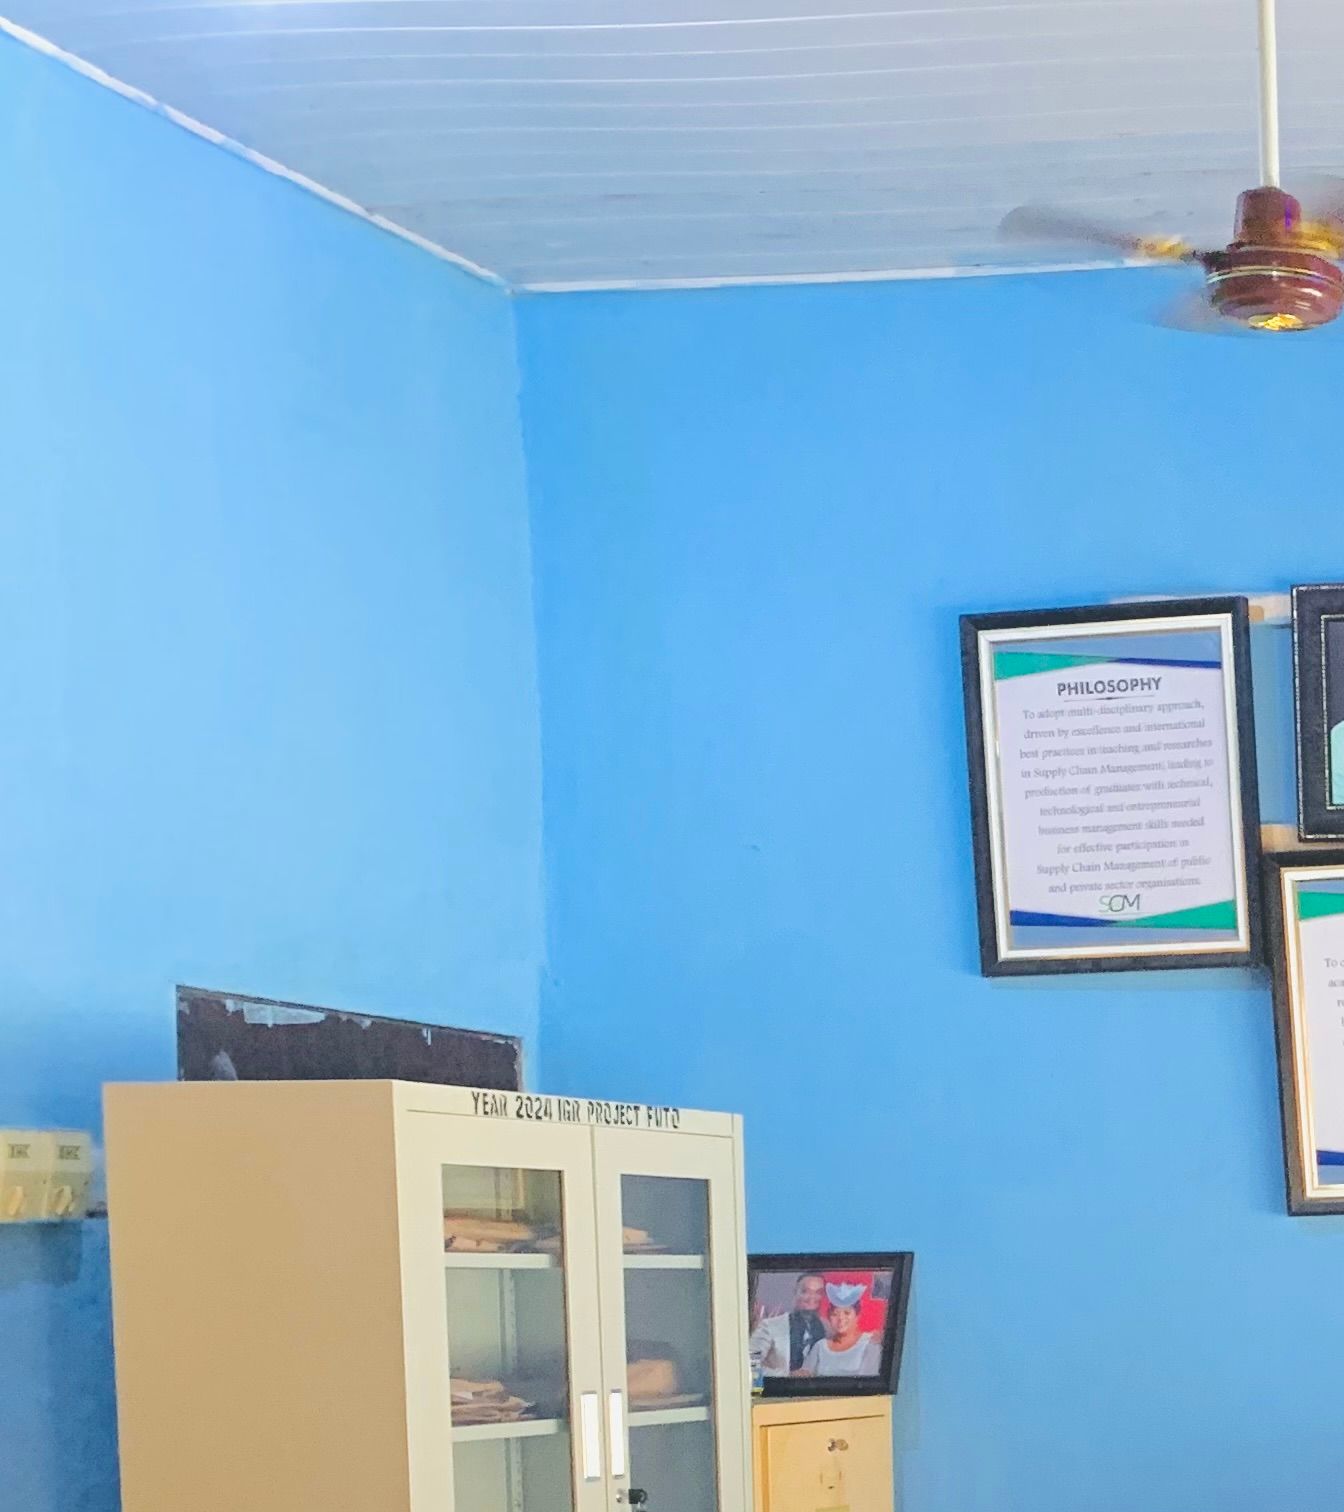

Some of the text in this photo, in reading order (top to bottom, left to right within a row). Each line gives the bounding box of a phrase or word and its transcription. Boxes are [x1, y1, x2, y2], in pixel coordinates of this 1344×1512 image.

[1057, 677, 1162, 696] PHILOSOPHY
[1072, 862, 1100, 872] Chain
[1324, 958, 1338, 968] To
[471, 1090, 508, 1117] YEAR
[515, 1095, 553, 1121] 2024
[587, 1100, 640, 1126] PROJECT
